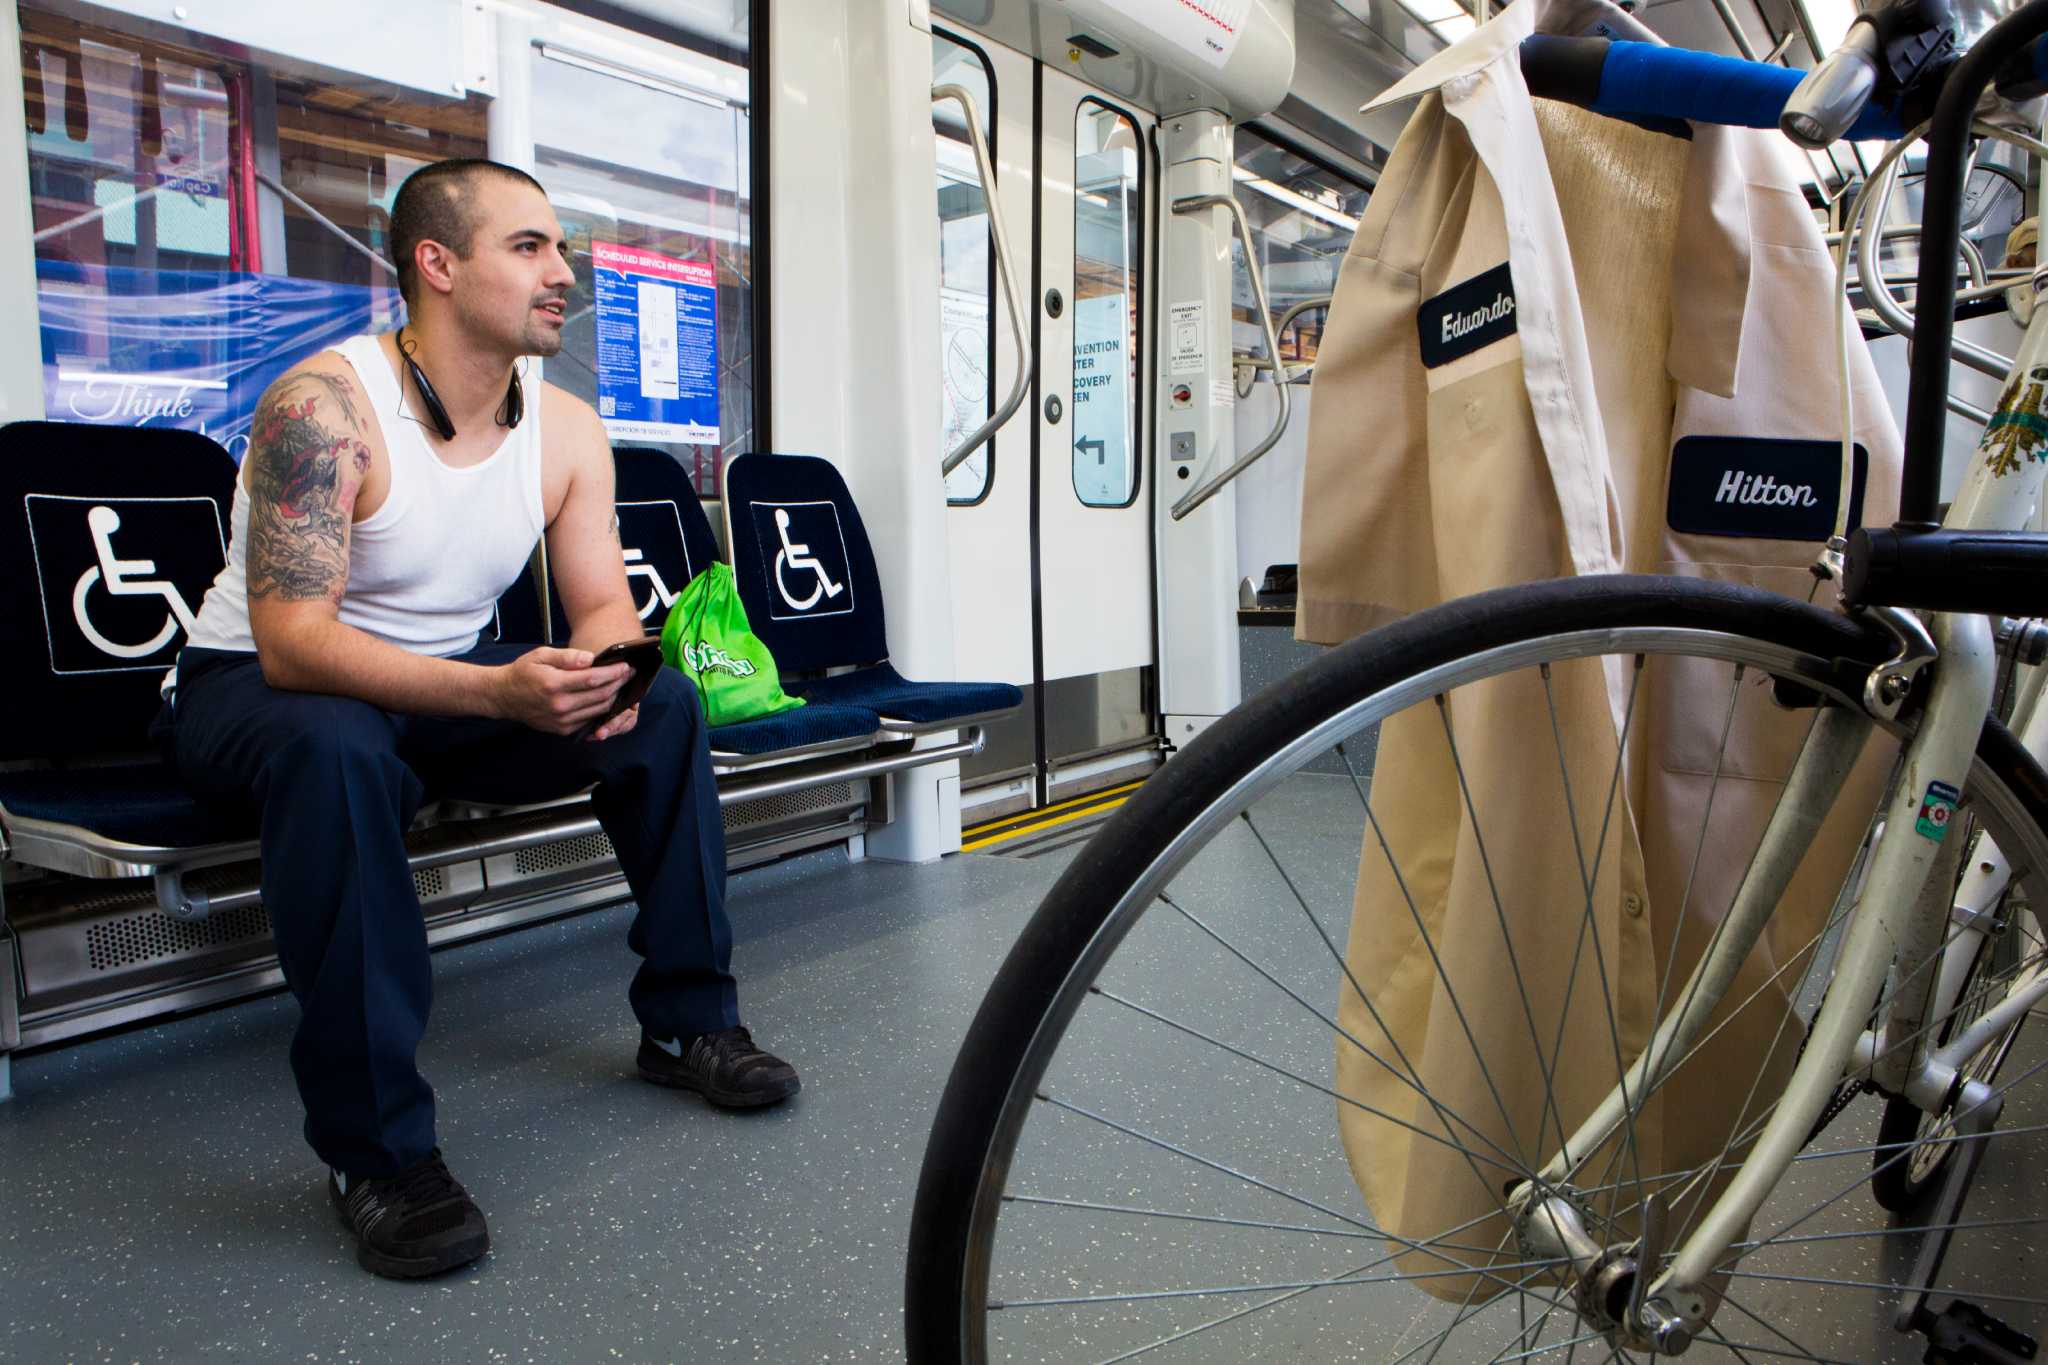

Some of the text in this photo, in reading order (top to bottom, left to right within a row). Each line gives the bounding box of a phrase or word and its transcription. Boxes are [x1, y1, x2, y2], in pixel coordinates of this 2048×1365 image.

[596, 246, 638, 264] SCHEDULED
[639, 256, 667, 271] SERVICE
[1441, 292, 1515, 344] Eduardo
[1074, 340, 1120, 356] VENTION
[1074, 358, 1095, 369] TER
[69, 379, 194, 422] Think
[1715, 470, 1818, 508] Hilton
